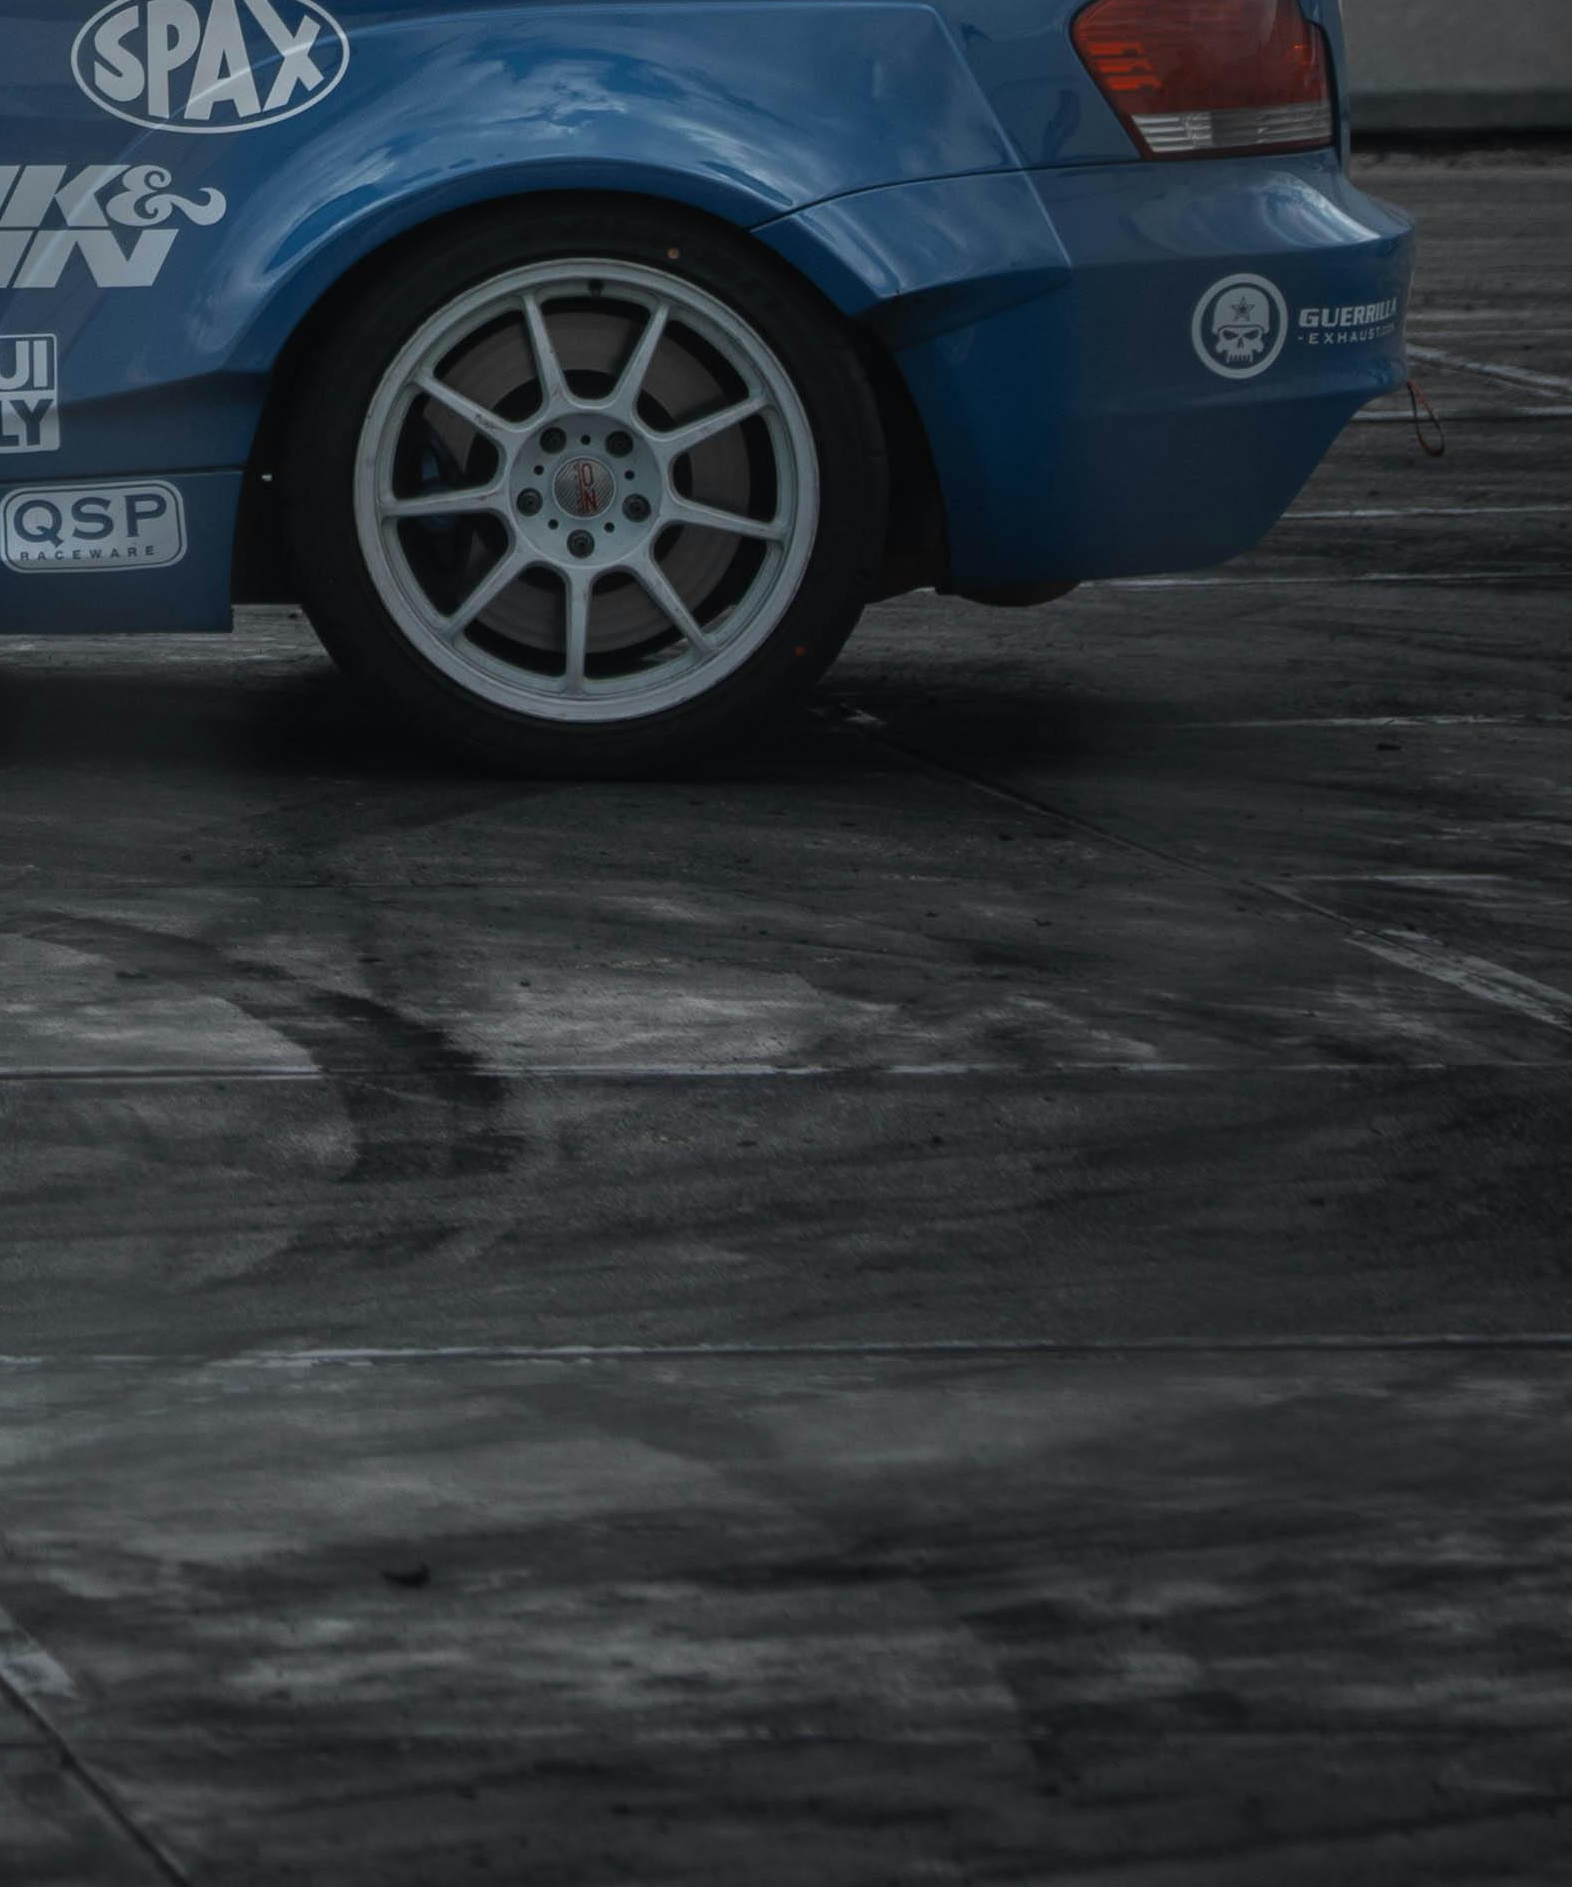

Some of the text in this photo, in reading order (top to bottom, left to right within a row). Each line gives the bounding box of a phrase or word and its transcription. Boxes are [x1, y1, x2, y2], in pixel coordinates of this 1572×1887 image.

[1298, 297, 1397, 327] GUERRILLA
[13, 493, 168, 547] QSP
[19, 544, 157, 562] RACEWARE
